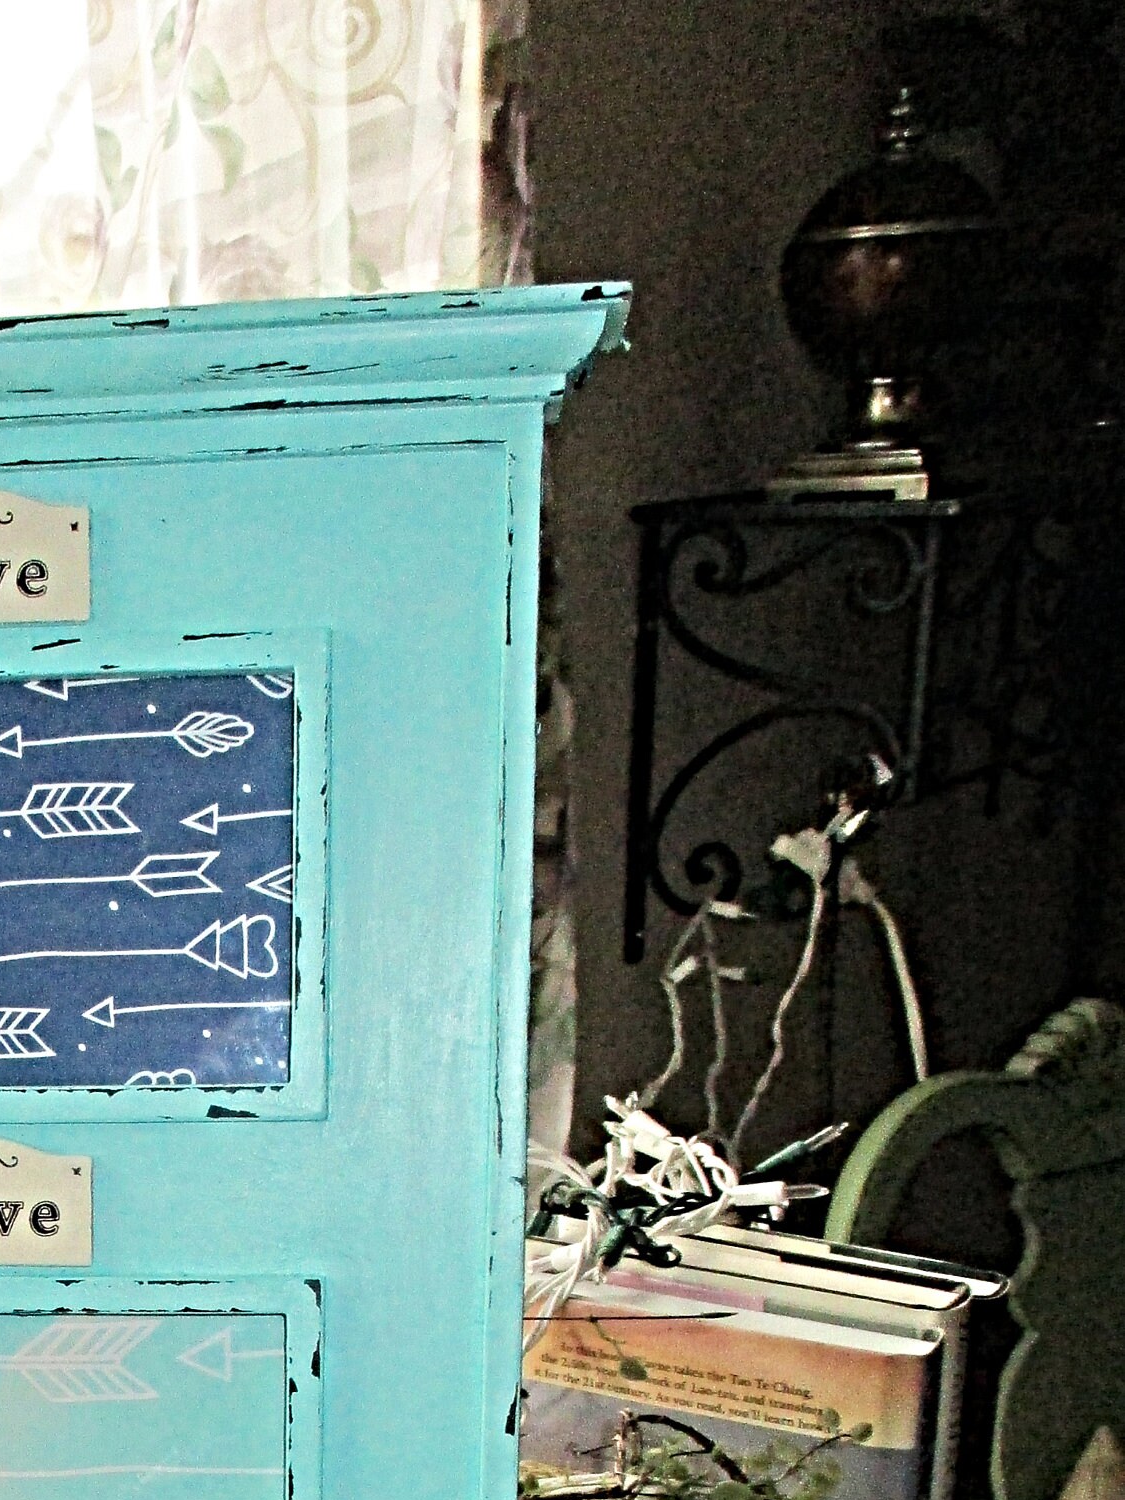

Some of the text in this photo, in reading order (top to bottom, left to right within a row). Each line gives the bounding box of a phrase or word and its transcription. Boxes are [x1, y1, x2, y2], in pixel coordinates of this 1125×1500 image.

[541, 1353, 558, 1364] the
[675, 1380, 687, 1390] of
[743, 1395, 765, 1406] and
[563, 1373, 580, 1384] the
[656, 1392, 670, 1403] As
[674, 1397, 693, 1409] you
[697, 1402, 726, 1415] read,
[764, 1414, 796, 1427] learn
[674, 1365, 704, 1378] takes
[730, 1373, 752, 1386] Tao
[755, 1378, 770, 1390] Te
